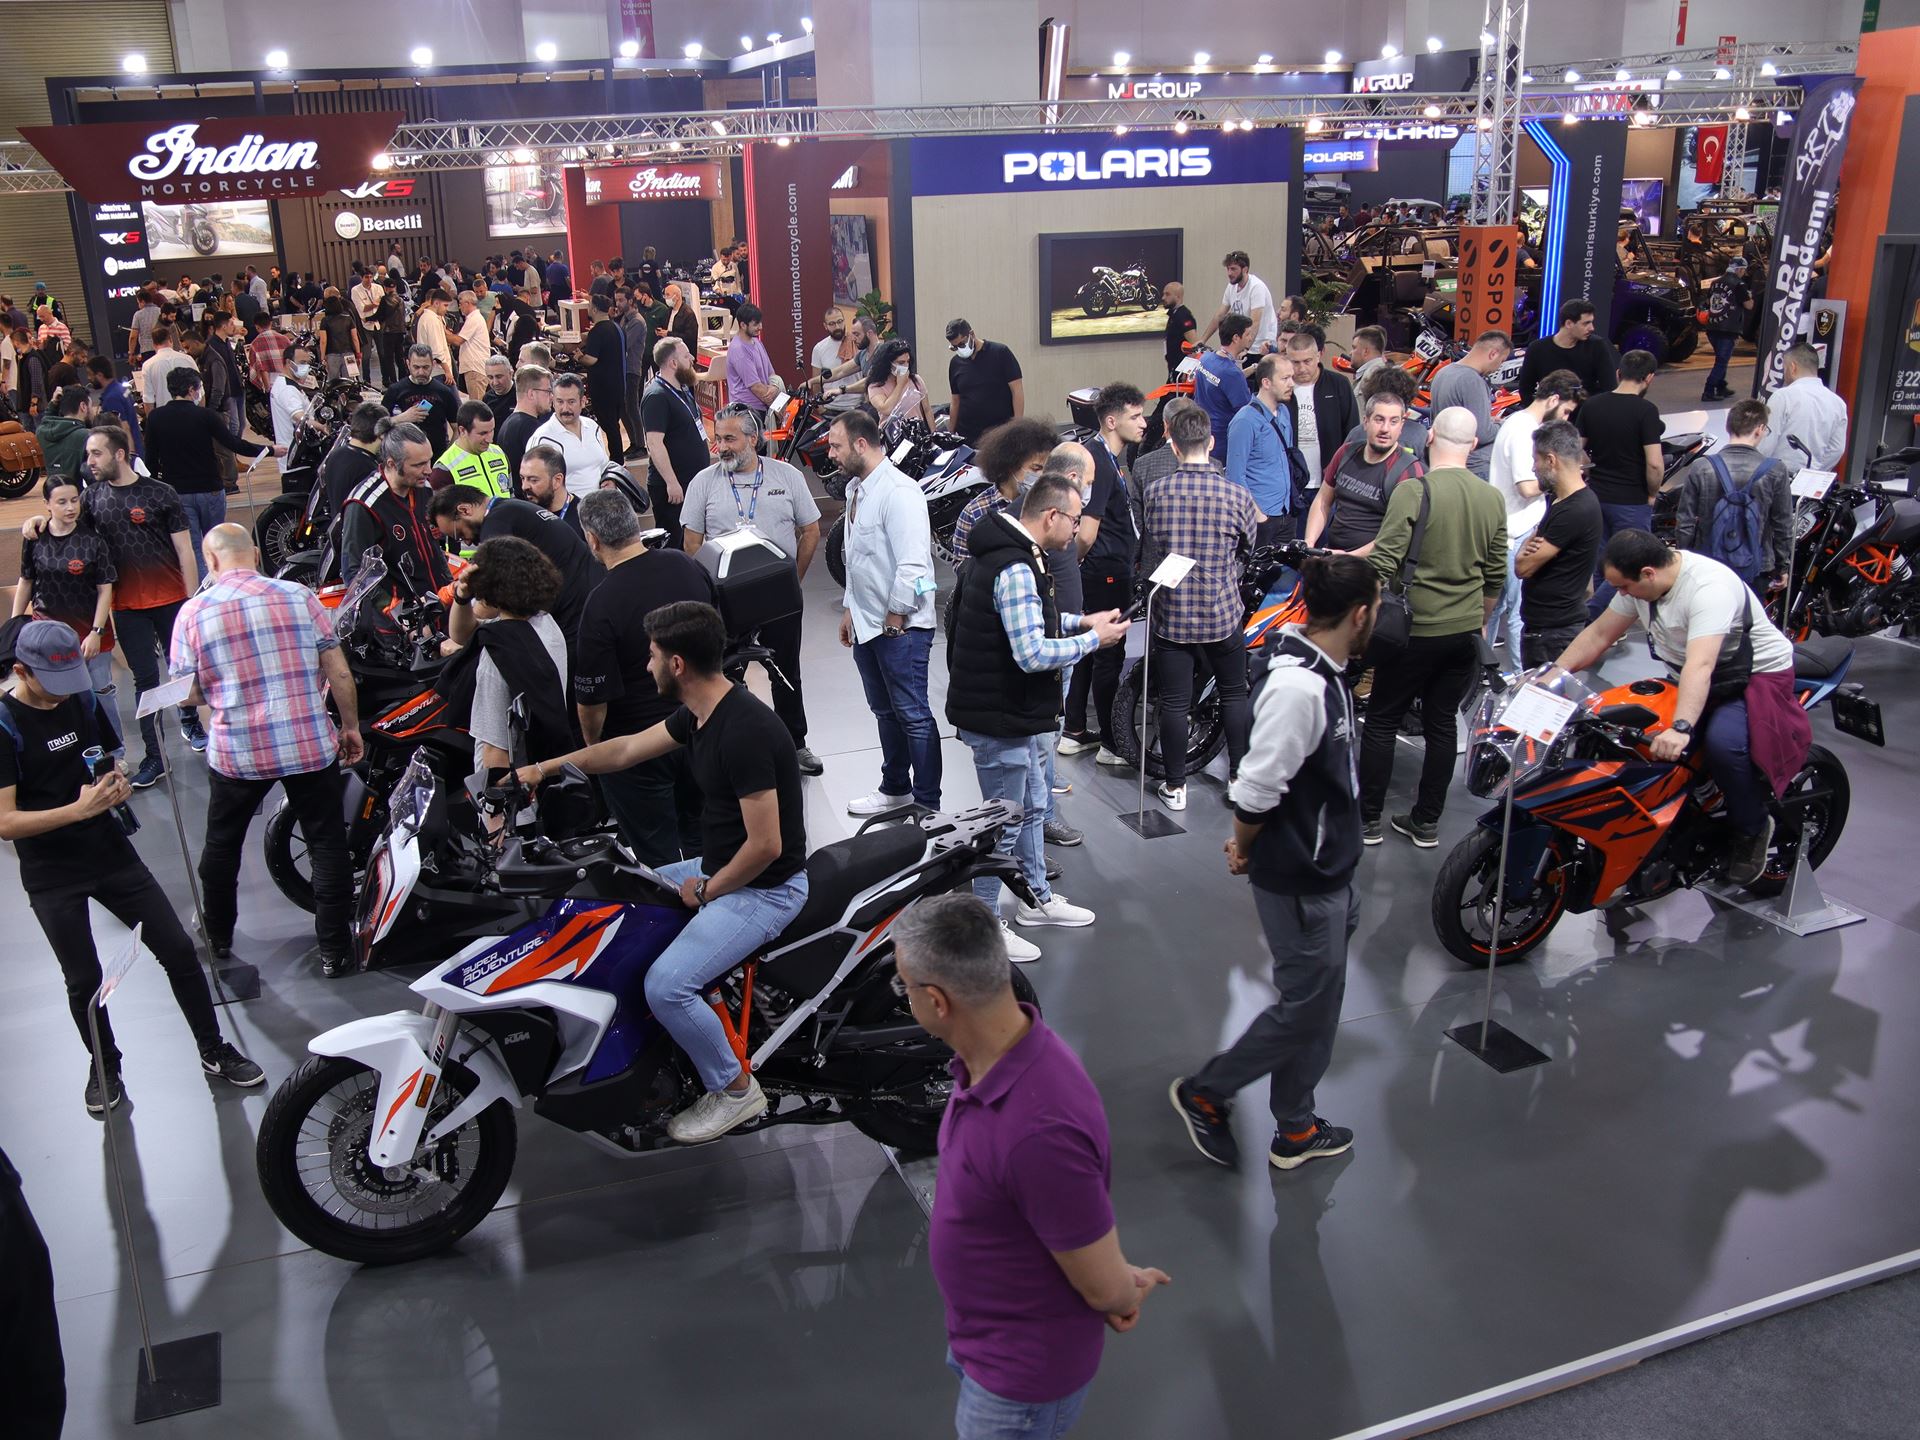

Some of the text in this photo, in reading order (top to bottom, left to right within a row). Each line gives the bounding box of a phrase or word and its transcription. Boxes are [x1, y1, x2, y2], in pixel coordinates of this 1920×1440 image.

[128, 123, 318, 181] Indian
[1303, 150, 1364, 163] POLARIS
[1003, 147, 1212, 183] POLARIS
[141, 175, 315, 196] MOTORCYCLE
[628, 167, 701, 192] Indian
[632, 190, 700, 199] MOTORCYCLE
[361, 214, 422, 232] Benelli
[1771, 234, 1799, 327] ART
[767, 488, 786, 497] KTM
[48, 733, 76, 749] TRUST
[462, 936, 545, 986] ADVENTURE
[462, 951, 499, 976] SUPER
[504, 1032, 531, 1045] KTM
